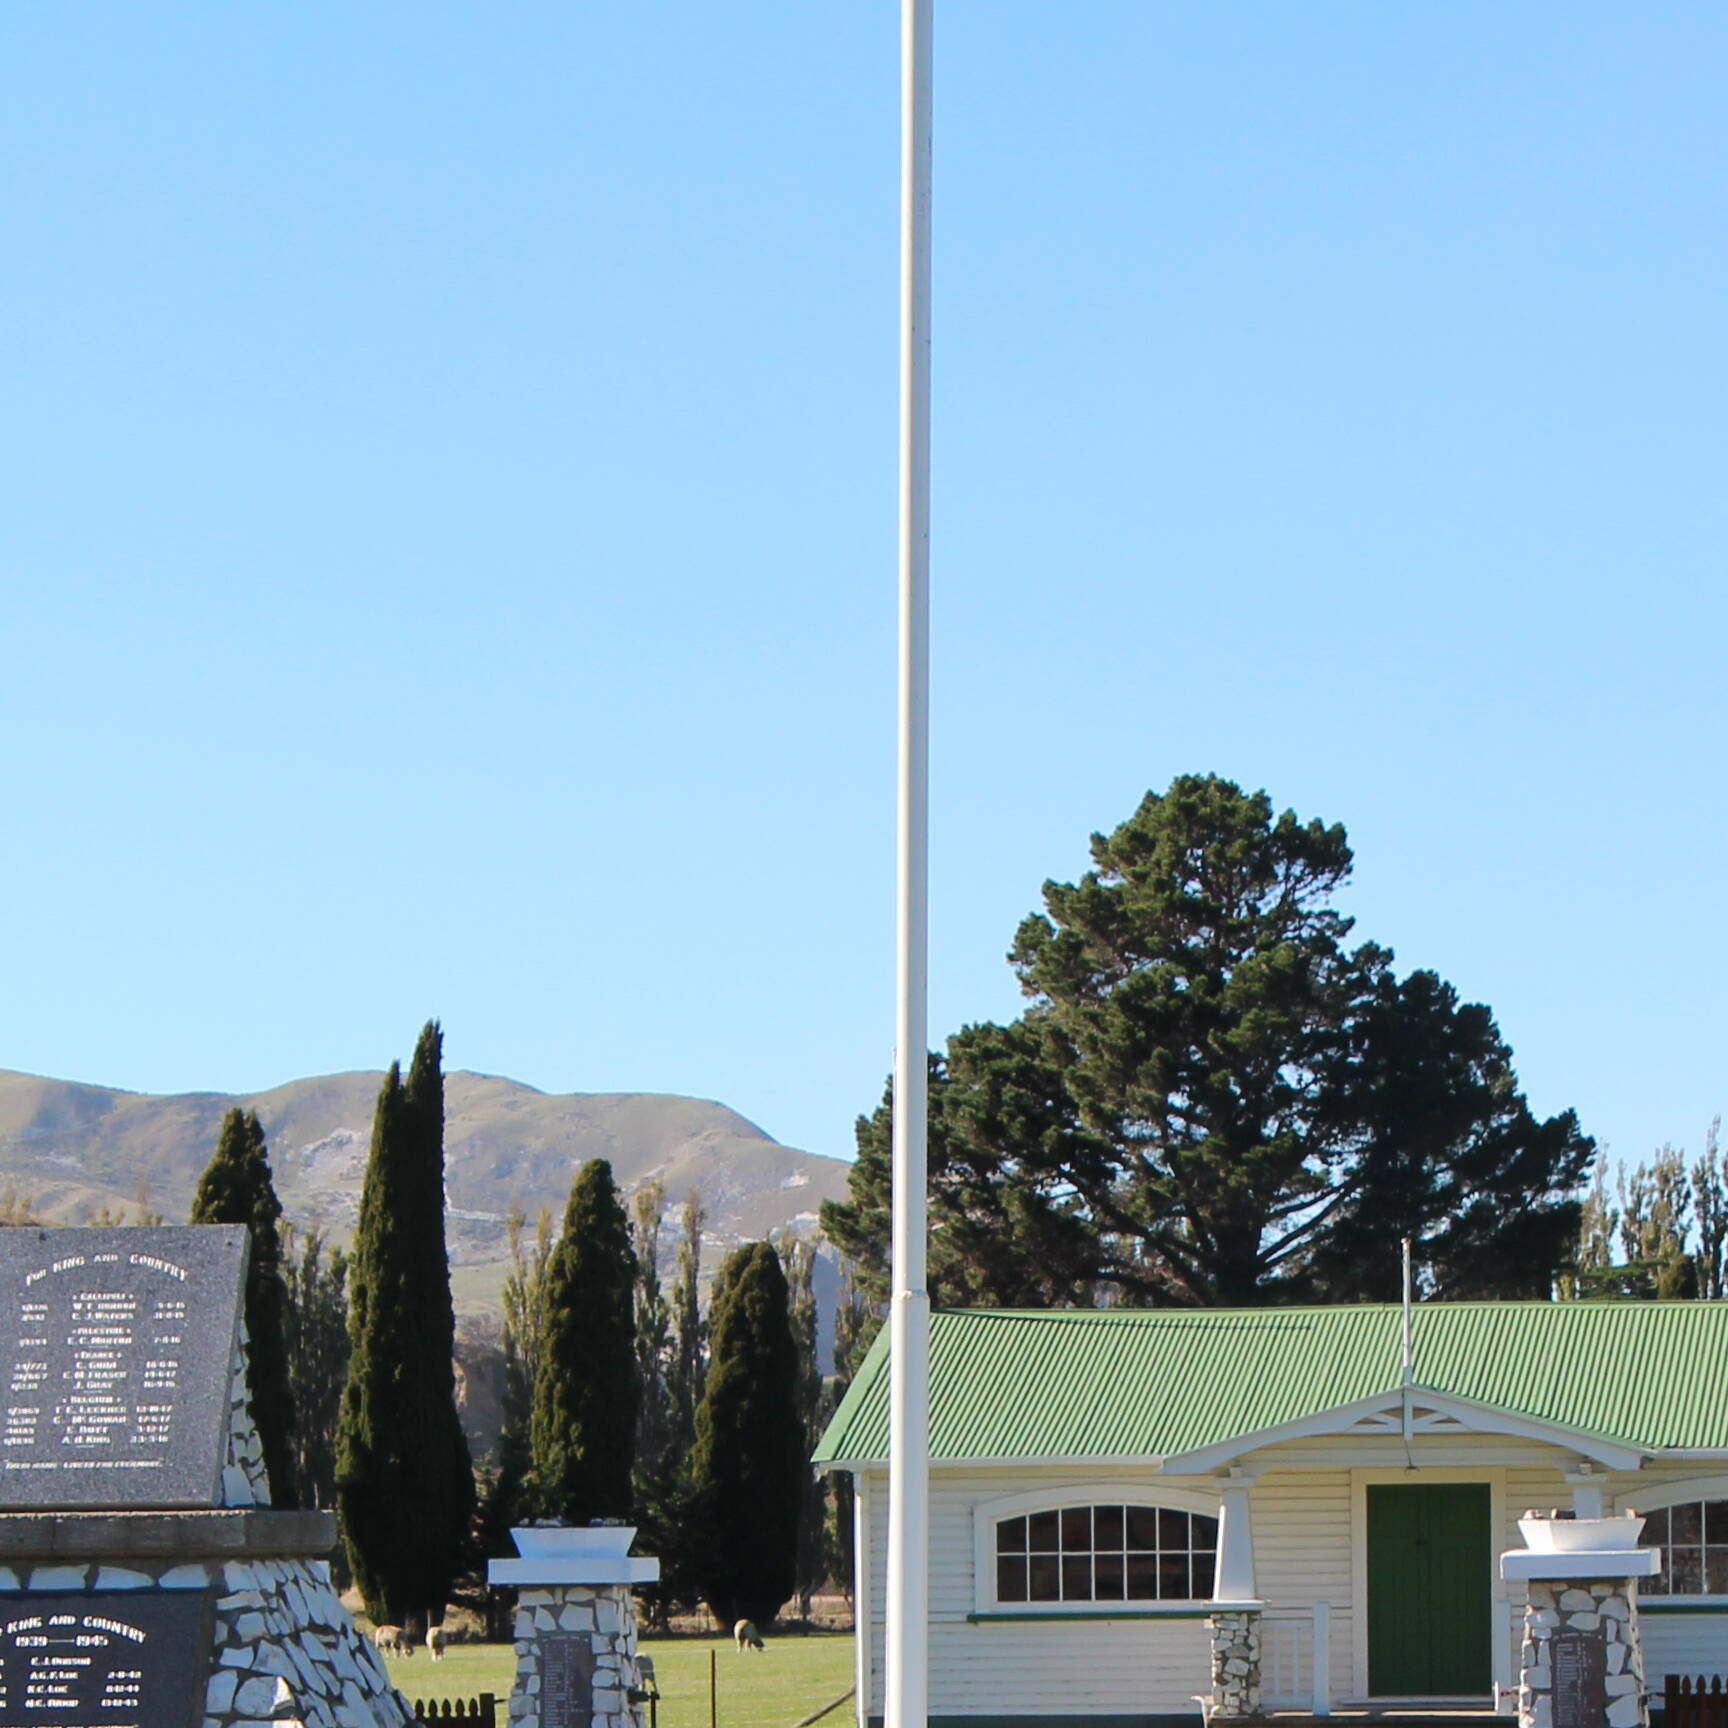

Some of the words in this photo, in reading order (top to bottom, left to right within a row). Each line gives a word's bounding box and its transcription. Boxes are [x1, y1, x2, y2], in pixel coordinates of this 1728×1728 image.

[53, 1256, 85, 1273] KING
[94, 1254, 119, 1263] AND
[130, 1253, 188, 1282] COUNTRY
[7, 1616, 43, 1634] KING
[48, 1615, 77, 1625] AND
[83, 1615, 146, 1644] COUNTRY
